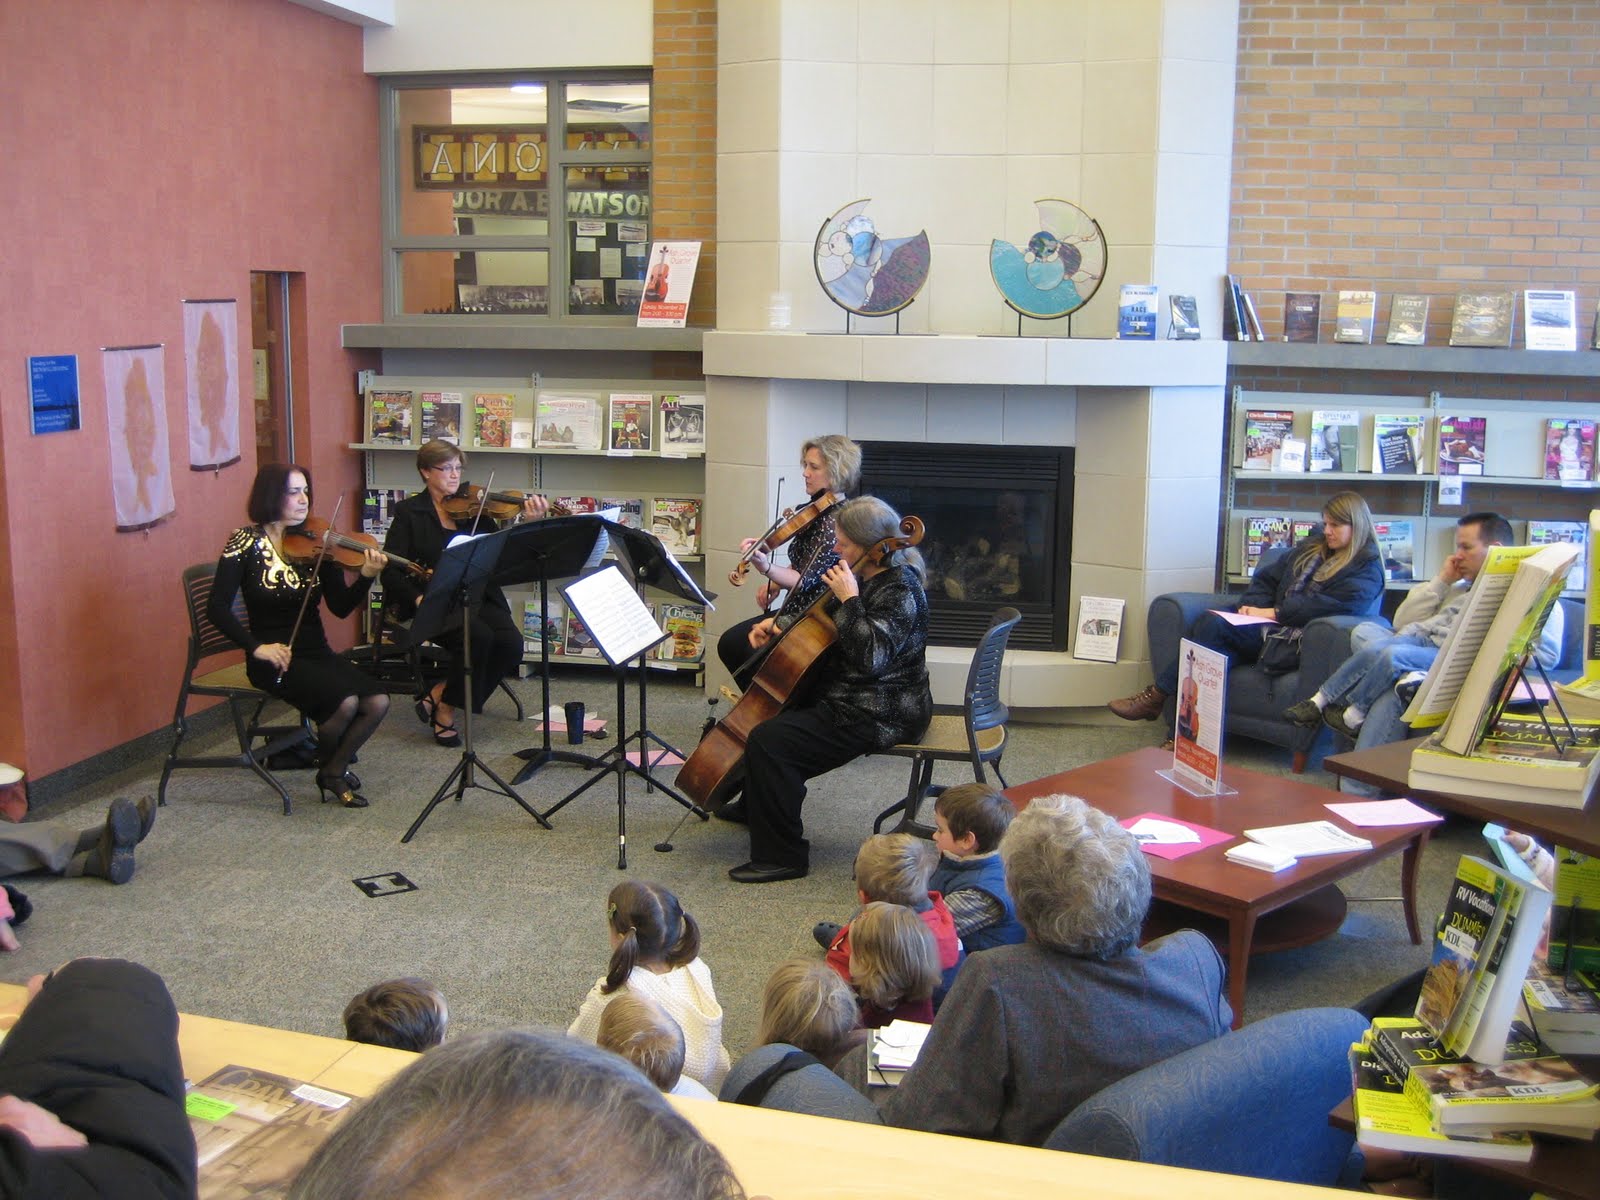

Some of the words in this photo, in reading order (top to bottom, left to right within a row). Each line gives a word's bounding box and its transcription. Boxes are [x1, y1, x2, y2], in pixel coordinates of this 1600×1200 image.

[602, 502, 640, 515] Biccling
[669, 604, 704, 622] Chicag
[1456, 885, 1470, 901] RV
[1468, 891, 1496, 917] Vacations
[1444, 930, 1461, 948] KDL
[1512, 1086, 1544, 1095] KDL
